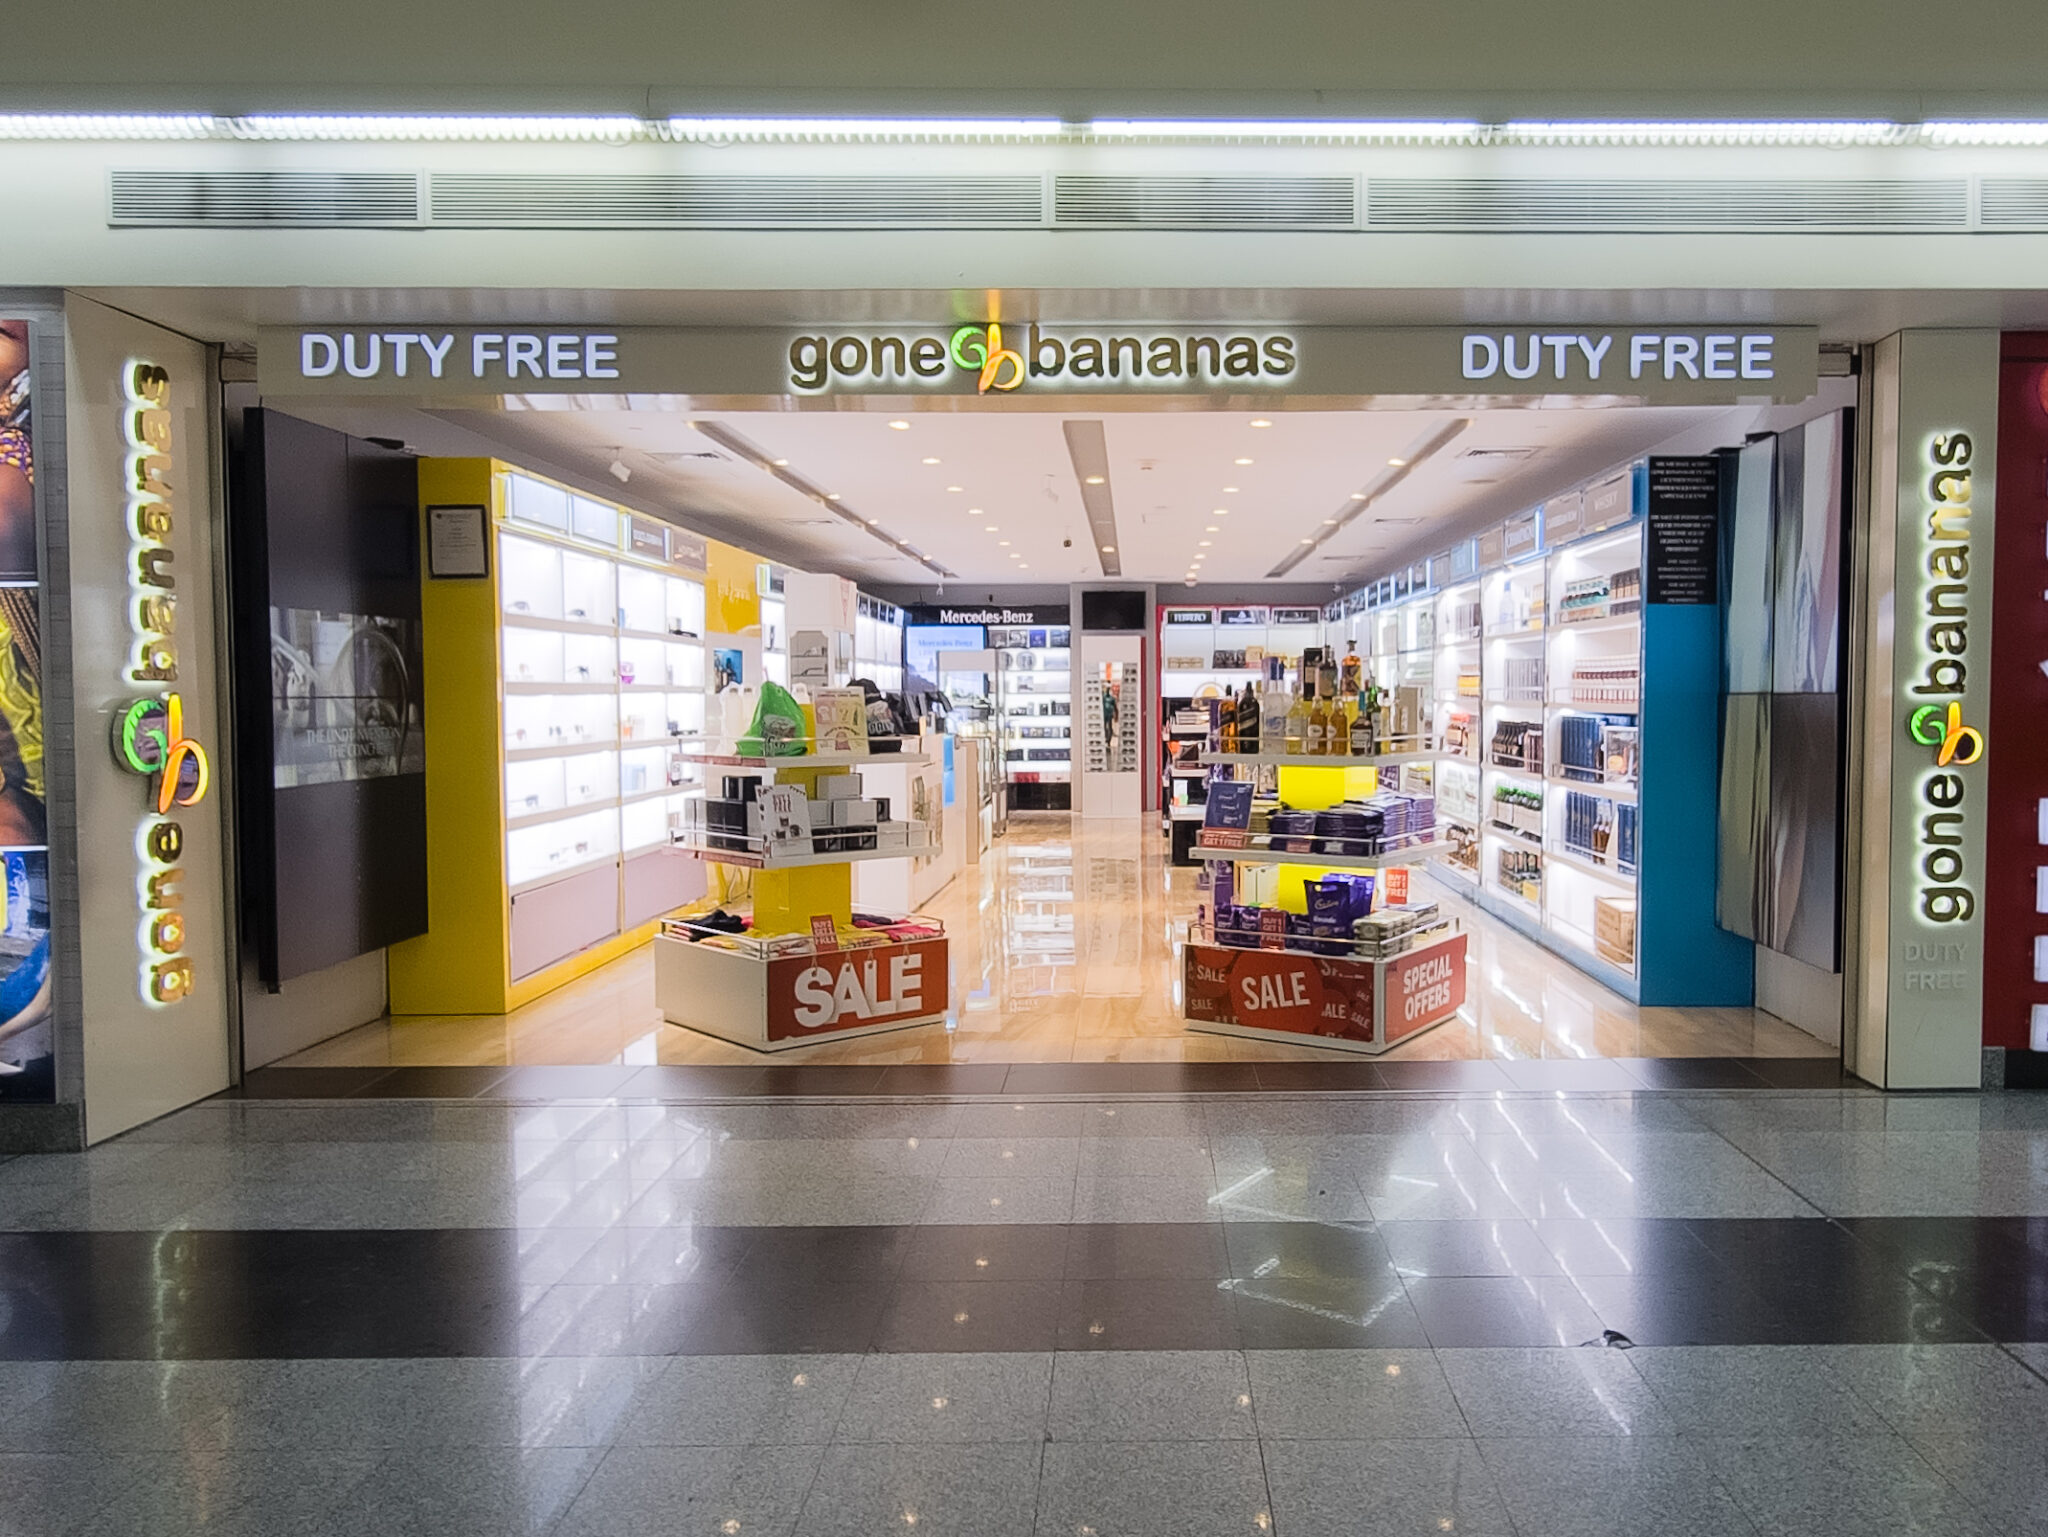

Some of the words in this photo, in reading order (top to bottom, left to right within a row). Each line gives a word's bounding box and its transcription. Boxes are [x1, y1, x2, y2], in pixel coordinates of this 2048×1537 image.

[301, 333, 454, 379] DUTY
[472, 334, 620, 379] FREE
[789, 335, 946, 389] gone
[1028, 322, 1297, 377] bananas
[1461, 334, 1613, 379] DUTY
[1630, 335, 1774, 379] FREE
[130, 363, 178, 682] bananas
[1912, 433, 1973, 694] bananas
[940, 609, 1034, 624] Mercedes-Benz
[1921, 774, 1975, 924] gone
[145, 822, 195, 1003] gone
[1904, 942, 1967, 961] DUTY
[794, 953, 922, 1028] SALE
[1197, 964, 1226, 984] SALE
[1241, 971, 1311, 1011] SALE
[1403, 953, 1453, 994] SPECIAL
[1904, 970, 1967, 990] FREE
[1191, 998, 1214, 1011] SALE
[1351, 1011, 1371, 1029] SALE
[1404, 981, 1451, 1021] OFFERS
